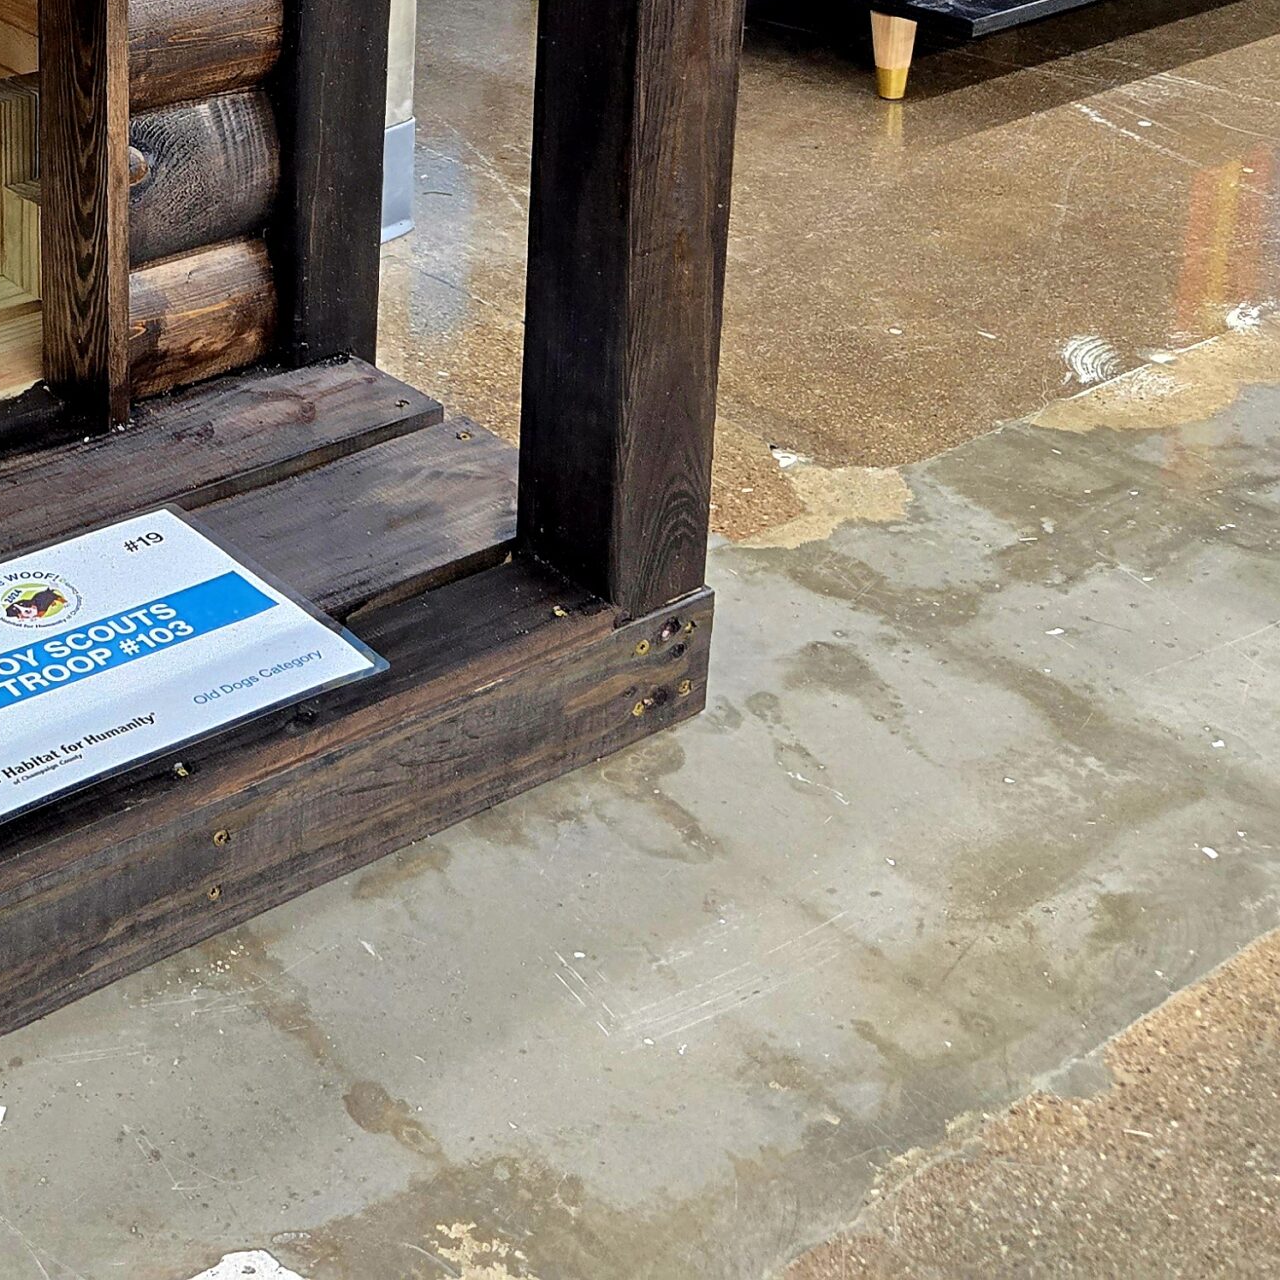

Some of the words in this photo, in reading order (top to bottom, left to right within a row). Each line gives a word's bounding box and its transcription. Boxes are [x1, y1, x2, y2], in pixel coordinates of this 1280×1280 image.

[123, 532, 164, 552] #19
[4, 571, 60, 581] WOOF!
[43, 603, 177, 658] SCOUTS
[119, 620, 194, 656] #103
[193, 690, 221, 705] Old
[220, 675, 259, 694] Dogs
[258, 650, 322, 678] Category
[2, 750, 61, 779] Habitat
[60, 740, 84, 755] for
[83, 712, 155, 745] Humanity
